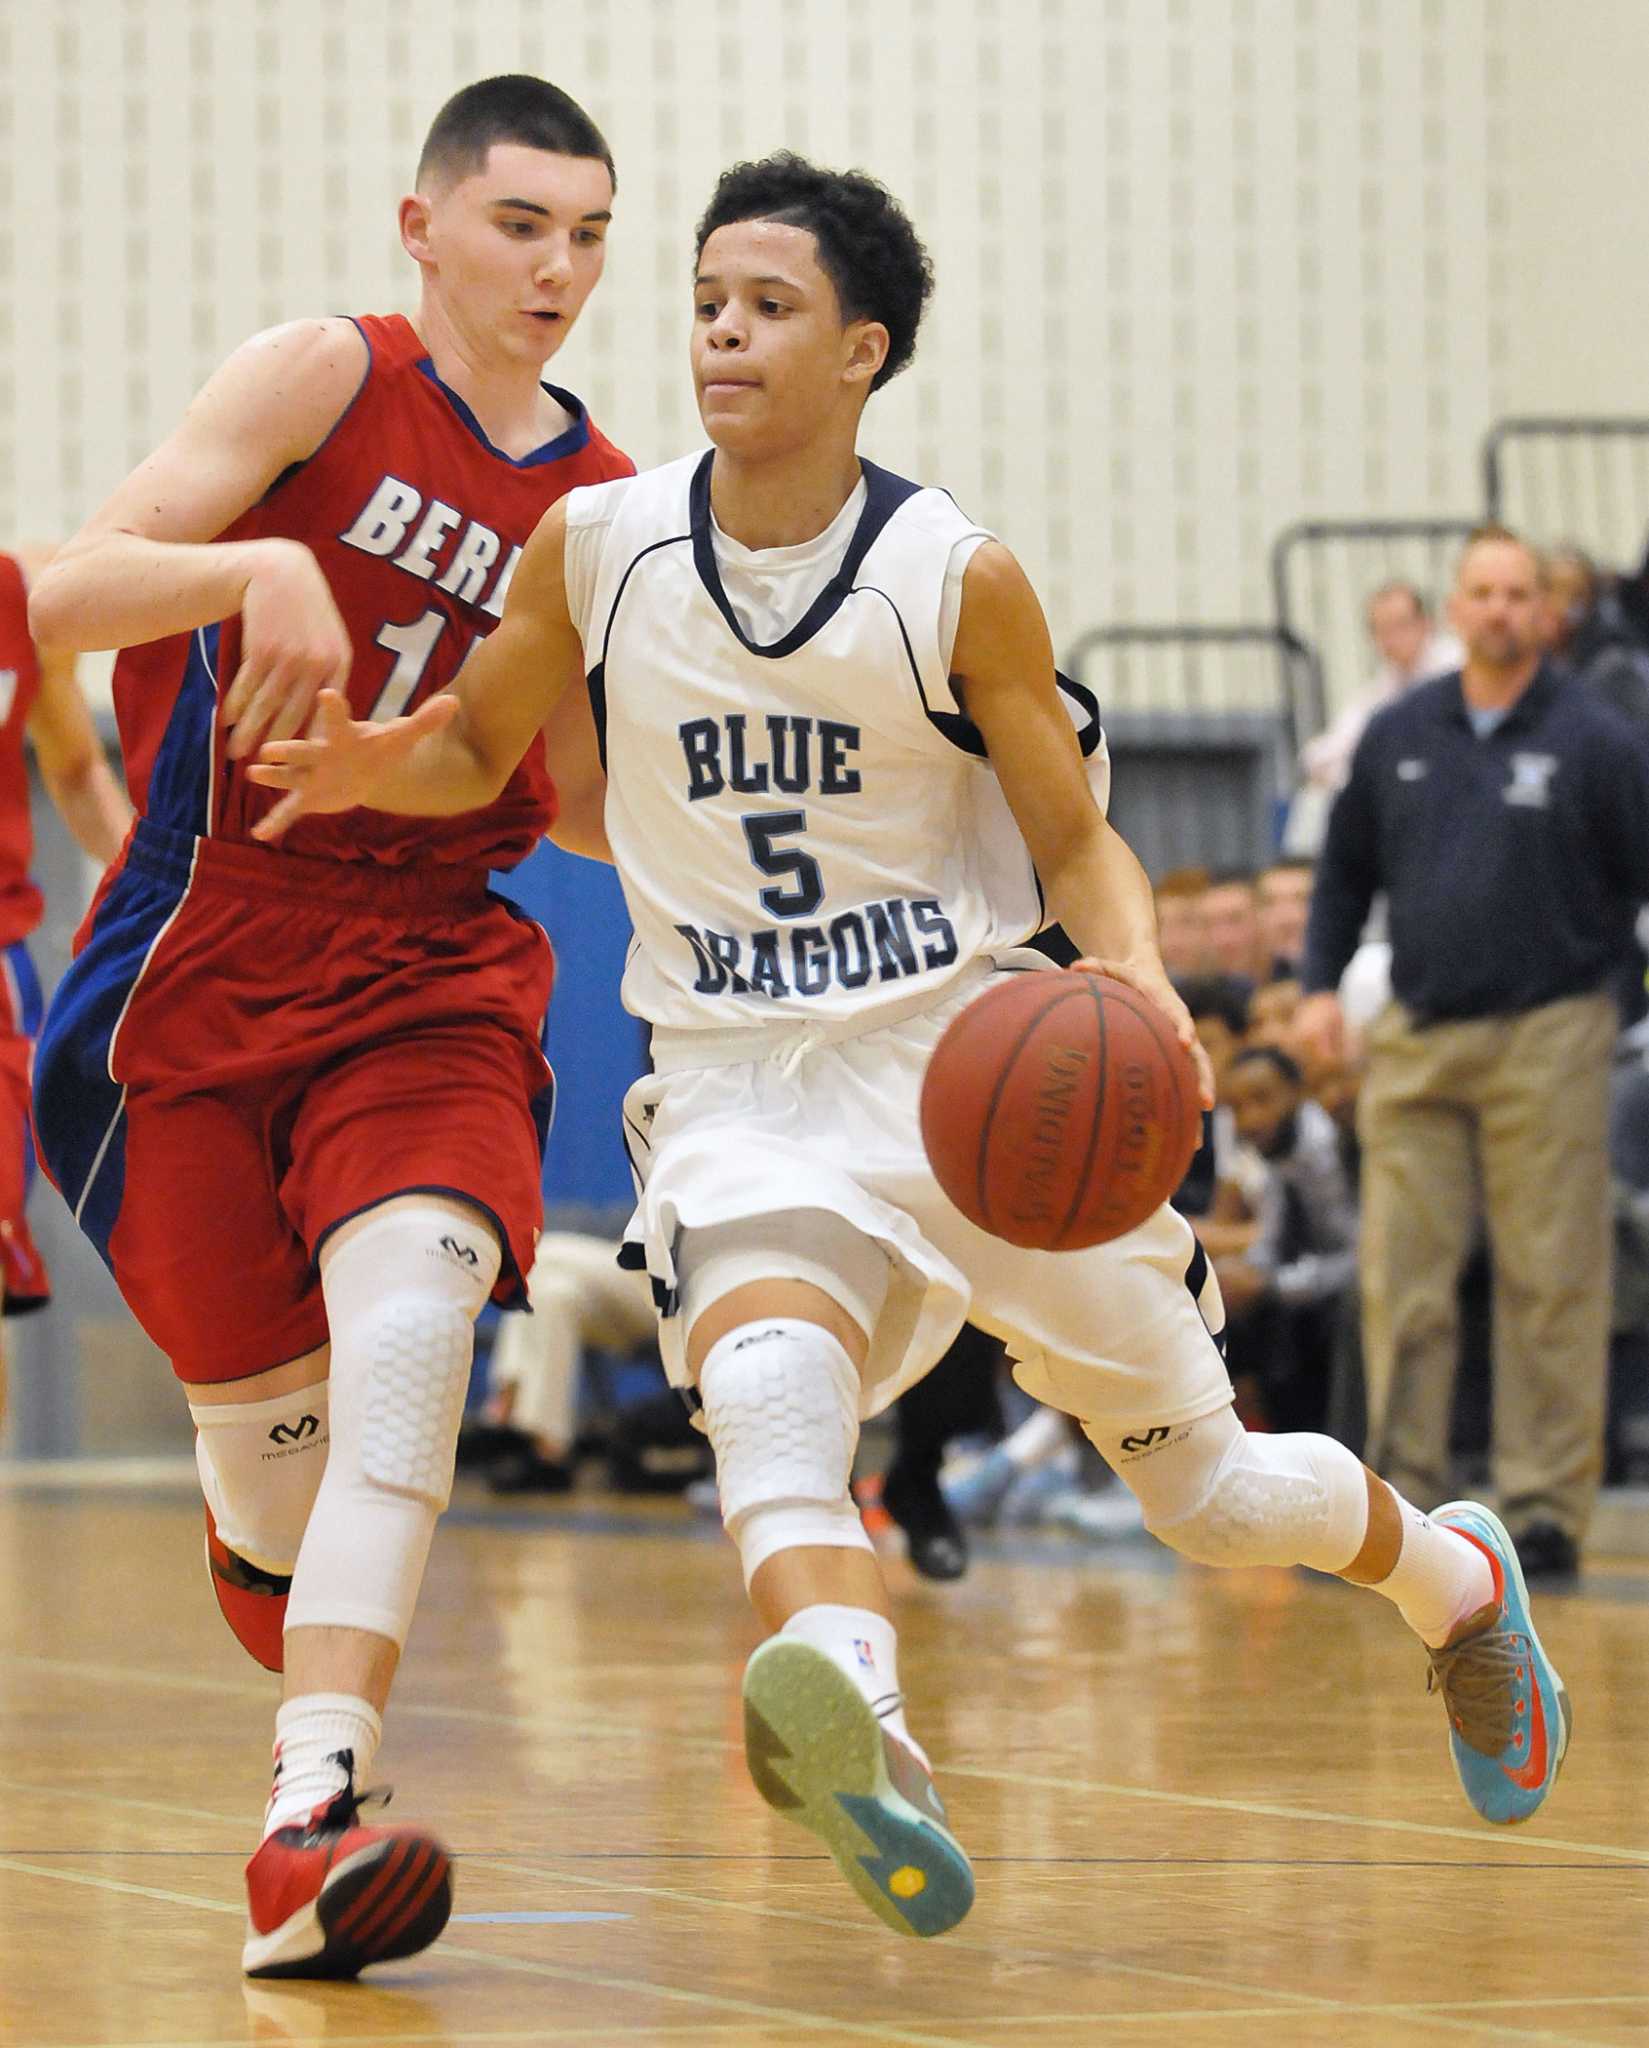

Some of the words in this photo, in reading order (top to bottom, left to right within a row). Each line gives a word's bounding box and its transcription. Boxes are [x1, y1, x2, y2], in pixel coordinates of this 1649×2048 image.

[678, 713, 862, 802] BLUE
[740, 808, 826, 921] 5
[673, 897, 959, 999] DRAGONS
